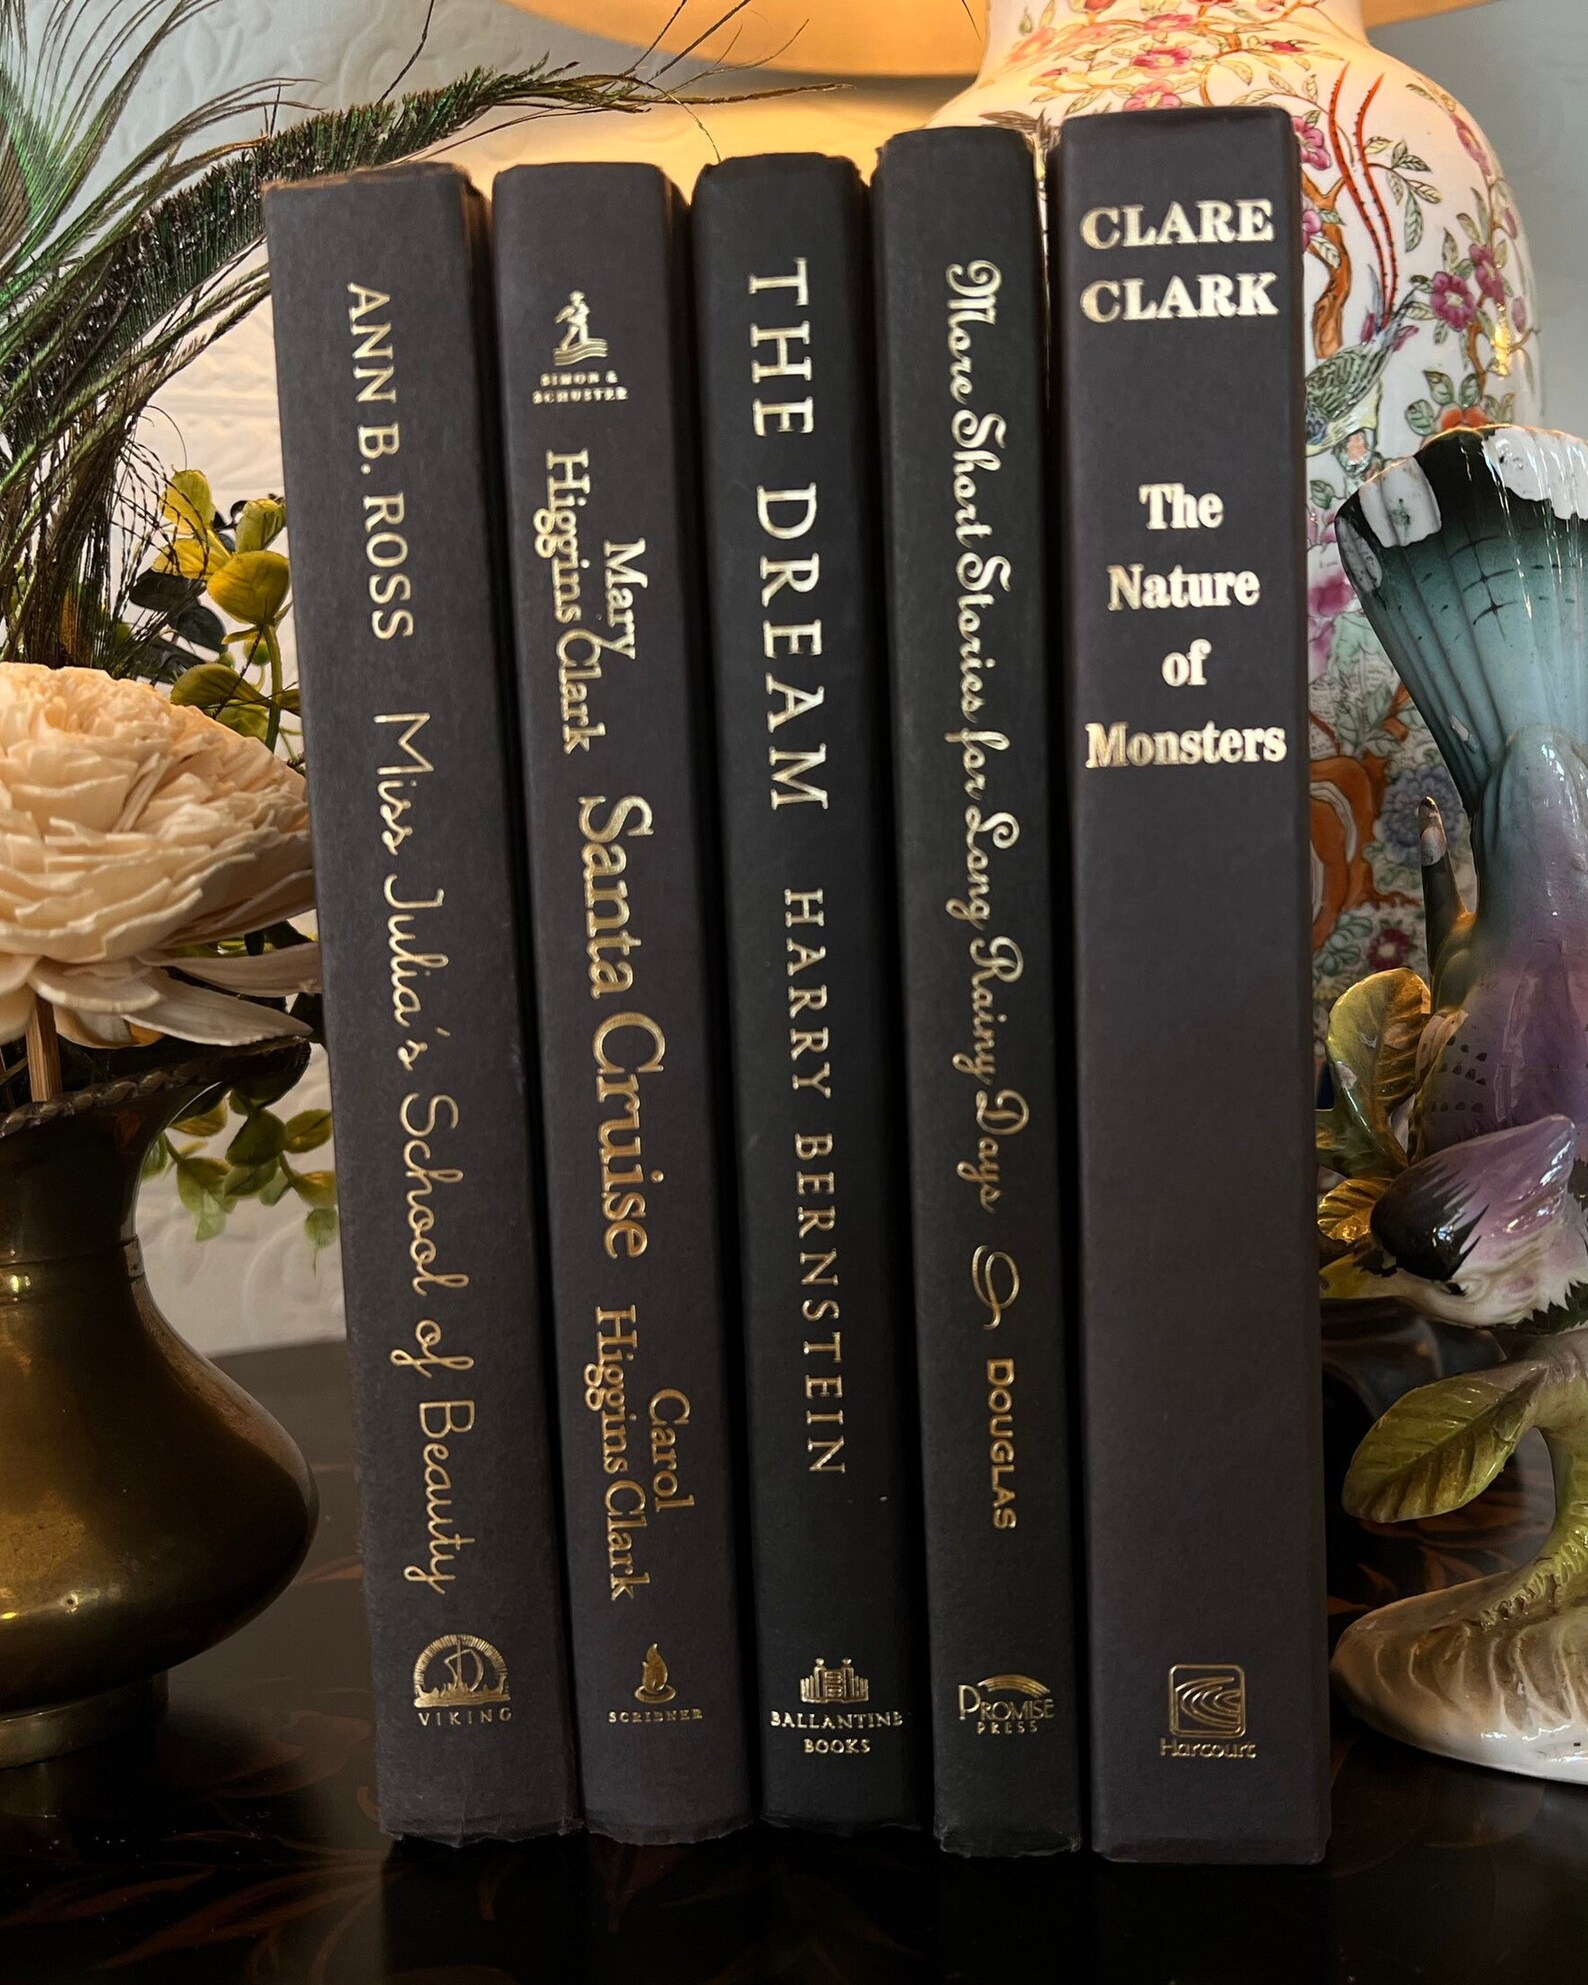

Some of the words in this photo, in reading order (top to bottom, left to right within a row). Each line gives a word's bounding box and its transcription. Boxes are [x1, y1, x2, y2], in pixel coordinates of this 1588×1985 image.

[1079, 198, 1275, 250] CLARE
[347, 282, 397, 403] ANN
[748, 257, 814, 437] THE
[945, 259, 1002, 405] More
[1079, 271, 1280, 323] CLARK
[532, 386, 628, 405] SCHUSTER
[540, 371, 600, 387] SIMON
[605, 370, 618, 384] &
[357, 422, 400, 475] B.
[951, 409, 1007, 548] Short
[1138, 482, 1224, 530] The
[362, 492, 414, 640] ROSS
[532, 449, 591, 624] Higgins
[599, 537, 649, 660] Mary
[1107, 563, 1261, 611] Nature
[555, 628, 611, 755] Clark
[756, 482, 829, 811] DREAM
[955, 552, 1012, 723] Stories
[1161, 638, 1213, 687] of
[373, 712, 434, 856] Miss
[944, 727, 1011, 801] for
[1084, 720, 1288, 769] Monsters
[578, 795, 654, 1000] Santa
[945, 805, 1020, 930] Long
[383, 873, 451, 1071] Julia's
[783, 888, 832, 1099] HARRY
[951, 935, 1024, 1085] Rainy
[399, 1092, 470, 1296] School
[592, 1012, 666, 1259] Cruise
[955, 1089, 1030, 1212] Days
[389, 1319, 475, 1378] of
[794, 1132, 846, 1474] BERNSTEIN
[583, 1304, 638, 1474] Higgins
[648, 1388, 696, 1513] Carol
[986, 1358, 1017, 1529] DOUGLAS
[403, 1400, 476, 1595] Beauty
[604, 1478, 656, 1602] Clark
[416, 1706, 512, 1727] VIKING
[608, 1708, 703, 1724] SCRIBNER
[770, 1710, 903, 1730] BALLANTINE
[803, 1738, 871, 1754] BOOKS
[958, 1683, 1054, 1721] PROMISE
[976, 1718, 1038, 1735] PRESS
[1160, 1735, 1257, 1759] Harcourt
